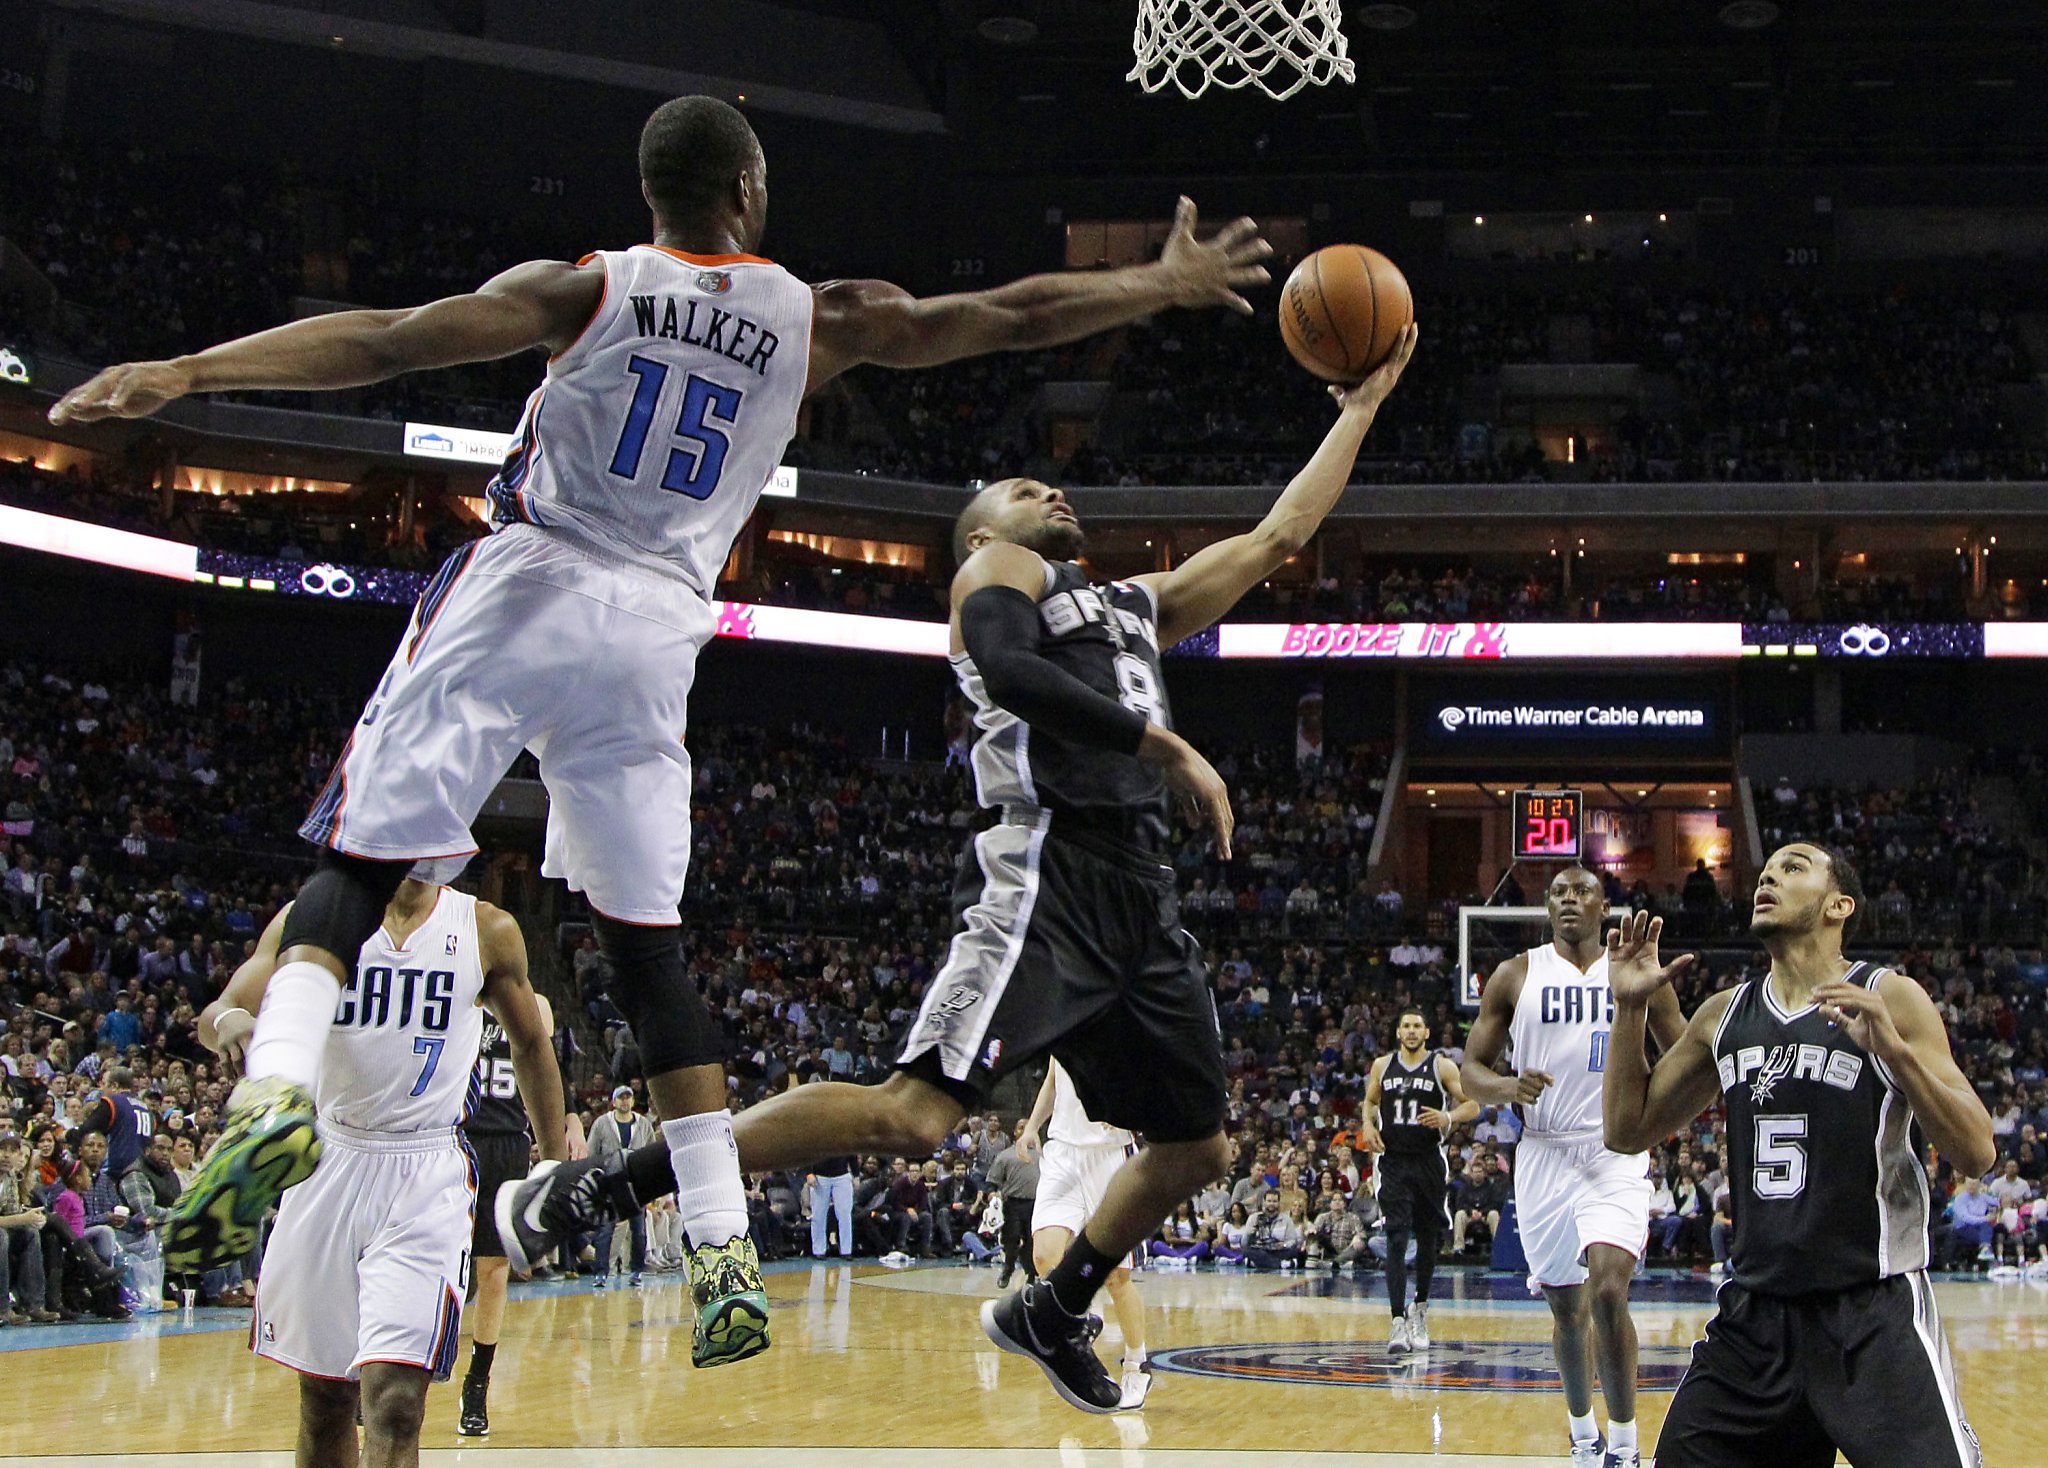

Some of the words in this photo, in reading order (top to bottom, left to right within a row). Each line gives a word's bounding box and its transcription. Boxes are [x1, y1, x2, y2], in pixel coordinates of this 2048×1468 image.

[530, 176, 564, 196] 231
[951, 259, 985, 276] 232
[1783, 247, 1819, 265] 201
[630, 295, 779, 376] WALKER
[608, 354, 744, 501] 15
[1281, 623, 1403, 657] BOOZE
[1417, 623, 1461, 657] IT
[1465, 706, 1512, 726] Time
[1513, 706, 1584, 726] Warner
[1585, 706, 1639, 726] Cable
[1641, 706, 1704, 726] Arena
[1525, 818, 1571, 853] 20
[409, 1036, 447, 1097] 7
[1717, 1043, 1864, 1106] SPURS
[1383, 1077, 1435, 1094] SPURS
[1392, 1099, 1421, 1125] 11
[1752, 1113, 1809, 1200] 5
